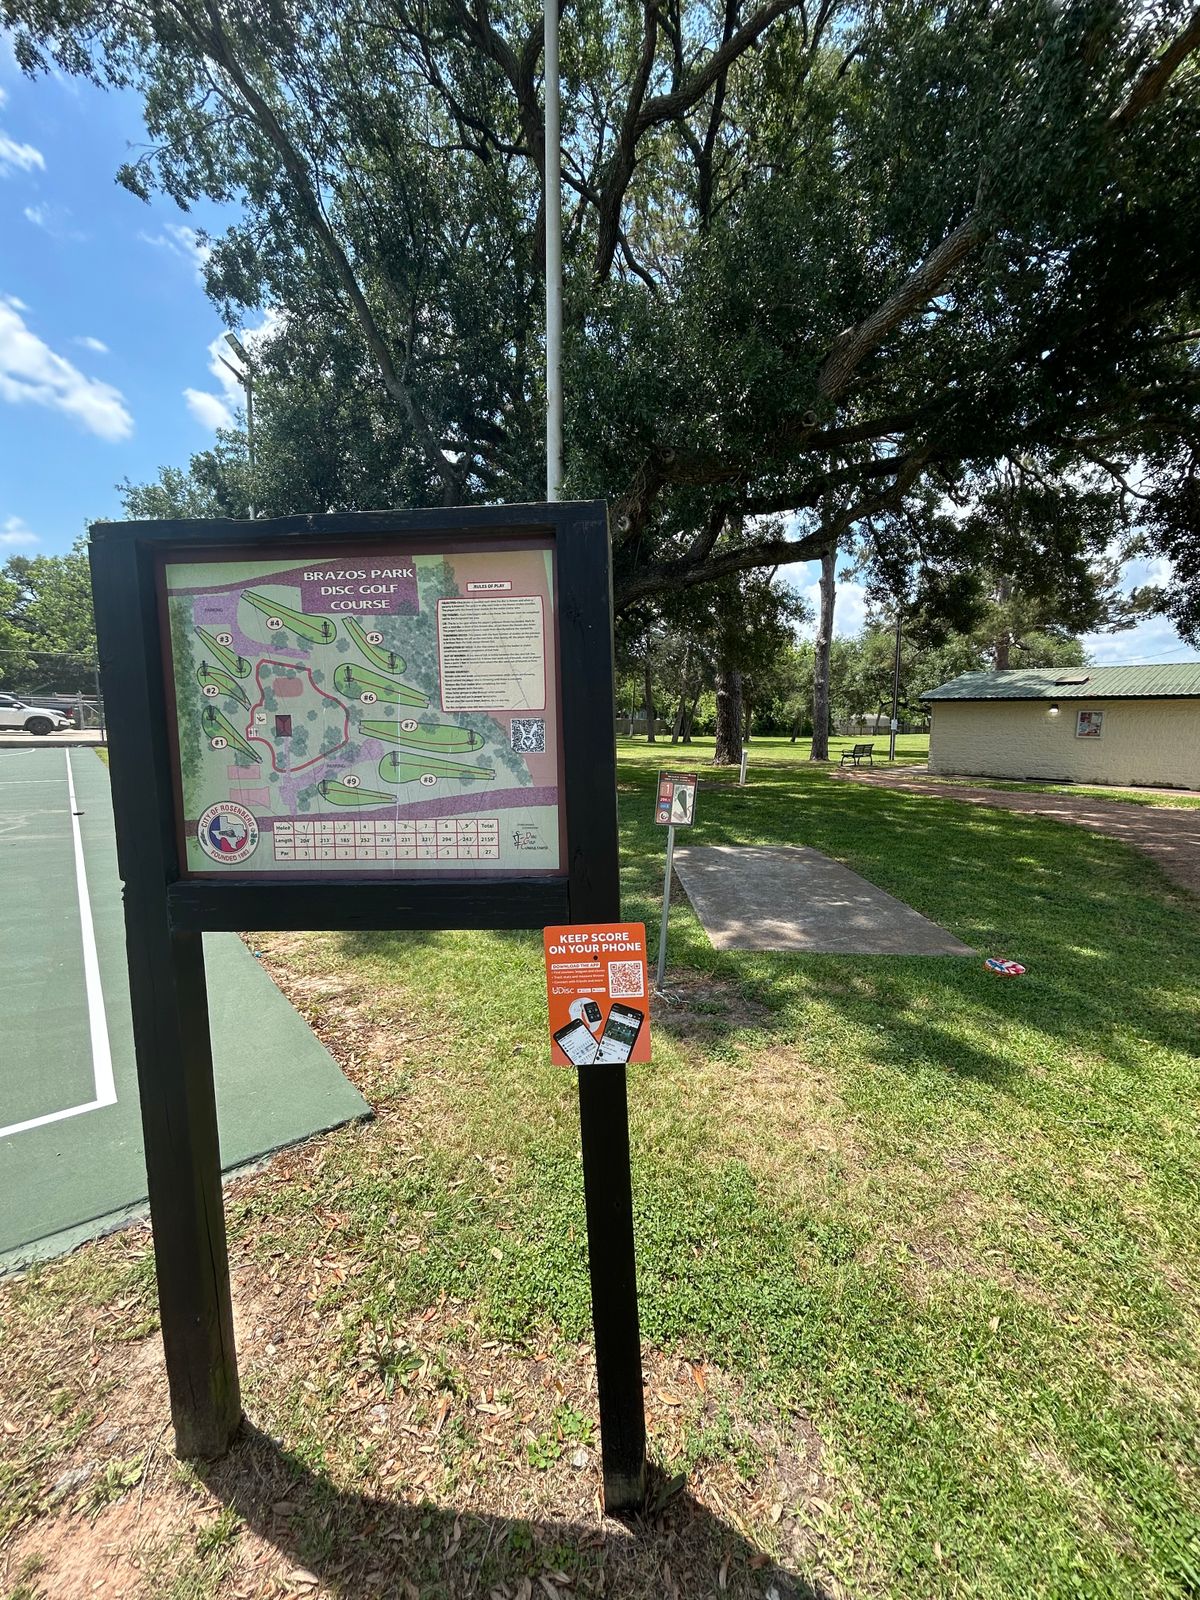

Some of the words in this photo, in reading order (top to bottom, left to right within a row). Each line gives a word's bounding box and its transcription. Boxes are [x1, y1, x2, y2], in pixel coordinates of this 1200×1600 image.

[304, 570, 366, 581] BRAZOS
[371, 568, 413, 579] PARK
[320, 585, 354, 596] DISC
[359, 584, 398, 594] GOLF
[330, 599, 390, 610] COURSE
[270, 619, 280, 628] #4
[219, 635, 230, 643] #3
[370, 634, 380, 642] #5
[201, 814, 212, 828] CITY
[210, 807, 220, 816] OF
[220, 805, 254, 828] ROSENBERG
[210, 850, 237, 862] FOUNDED
[560, 934, 589, 943] KEEP
[591, 932, 629, 942] SCORE
[549, 945, 566, 955] ON
[569, 944, 599, 953] YOUR
[602, 942, 642, 952] PHONE
